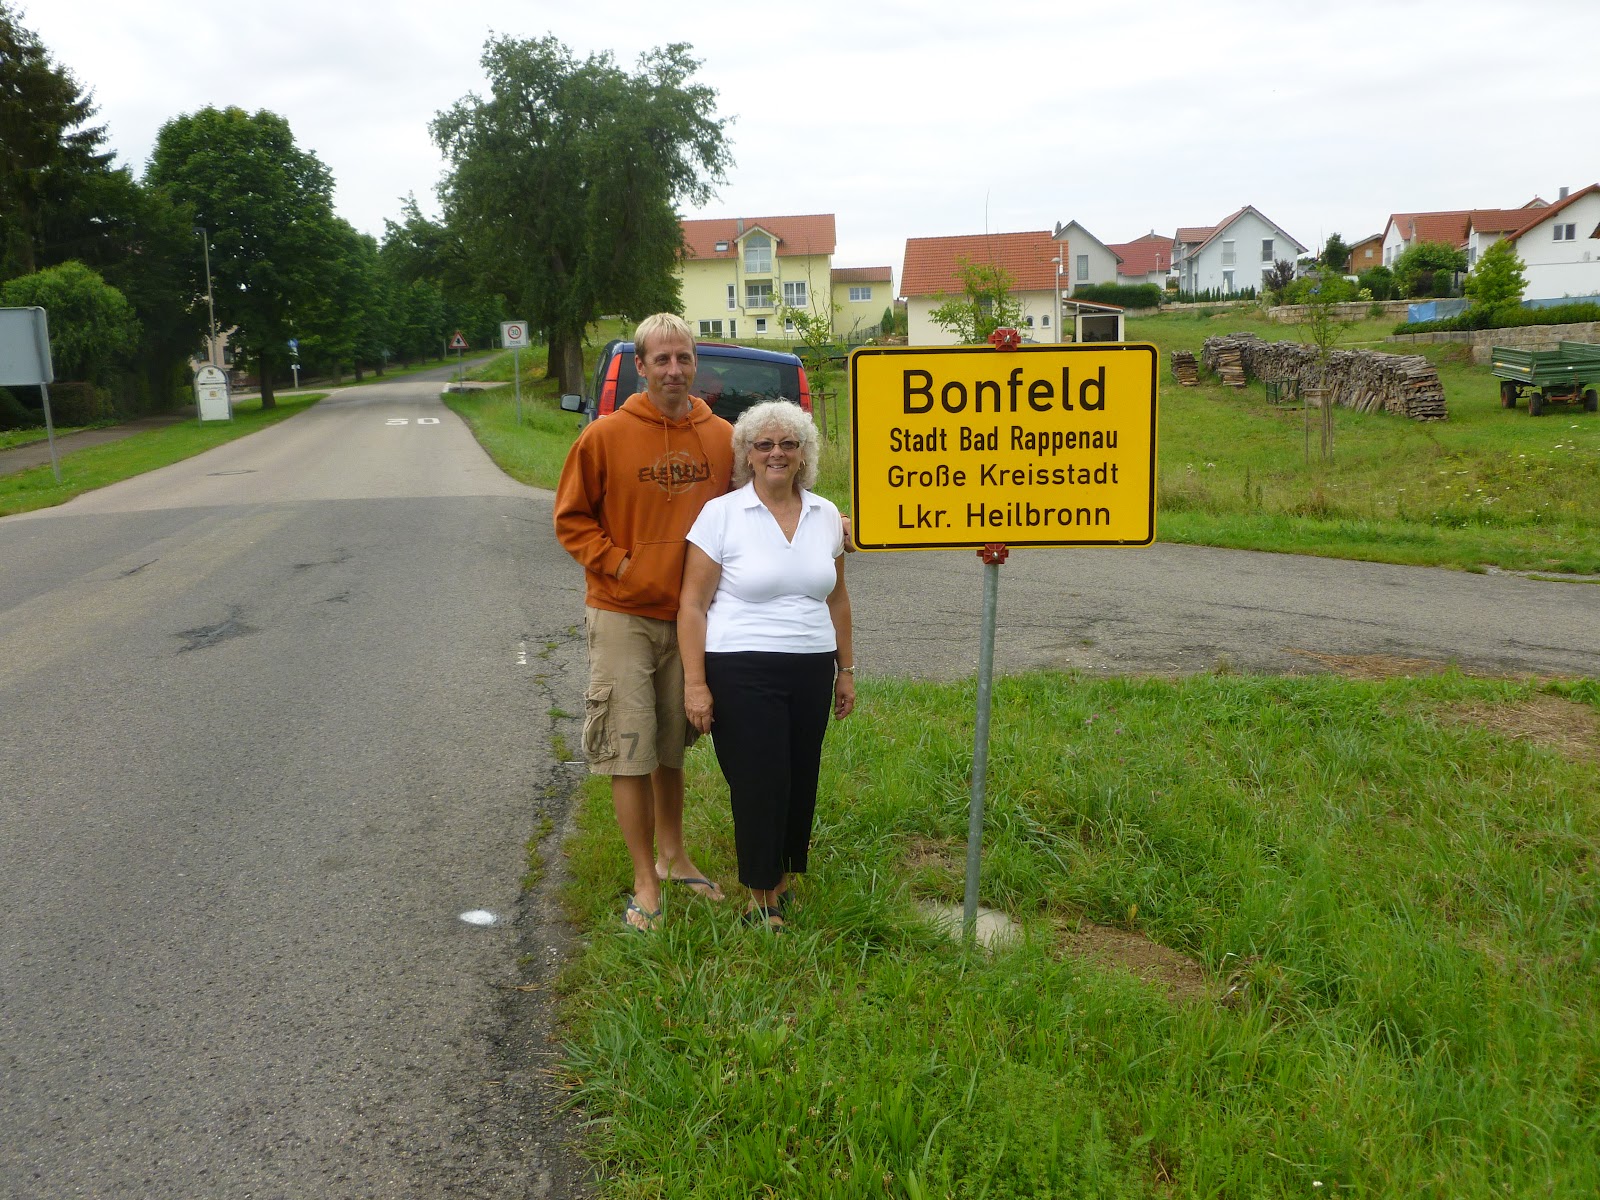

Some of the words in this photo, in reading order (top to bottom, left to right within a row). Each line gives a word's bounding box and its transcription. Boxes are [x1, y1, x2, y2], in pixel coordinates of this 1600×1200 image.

[903, 366, 1106, 415] Bonfeld
[889, 427, 948, 452] Stadt
[960, 426, 998, 451] Bad
[1011, 426, 1118, 456] Rappenau
[888, 465, 967, 487] Große
[980, 462, 1119, 486] Kreisstadt
[898, 504, 951, 529] Lkr.
[967, 502, 1110, 527] Heilbronn
[621, 732, 640, 760] 7
